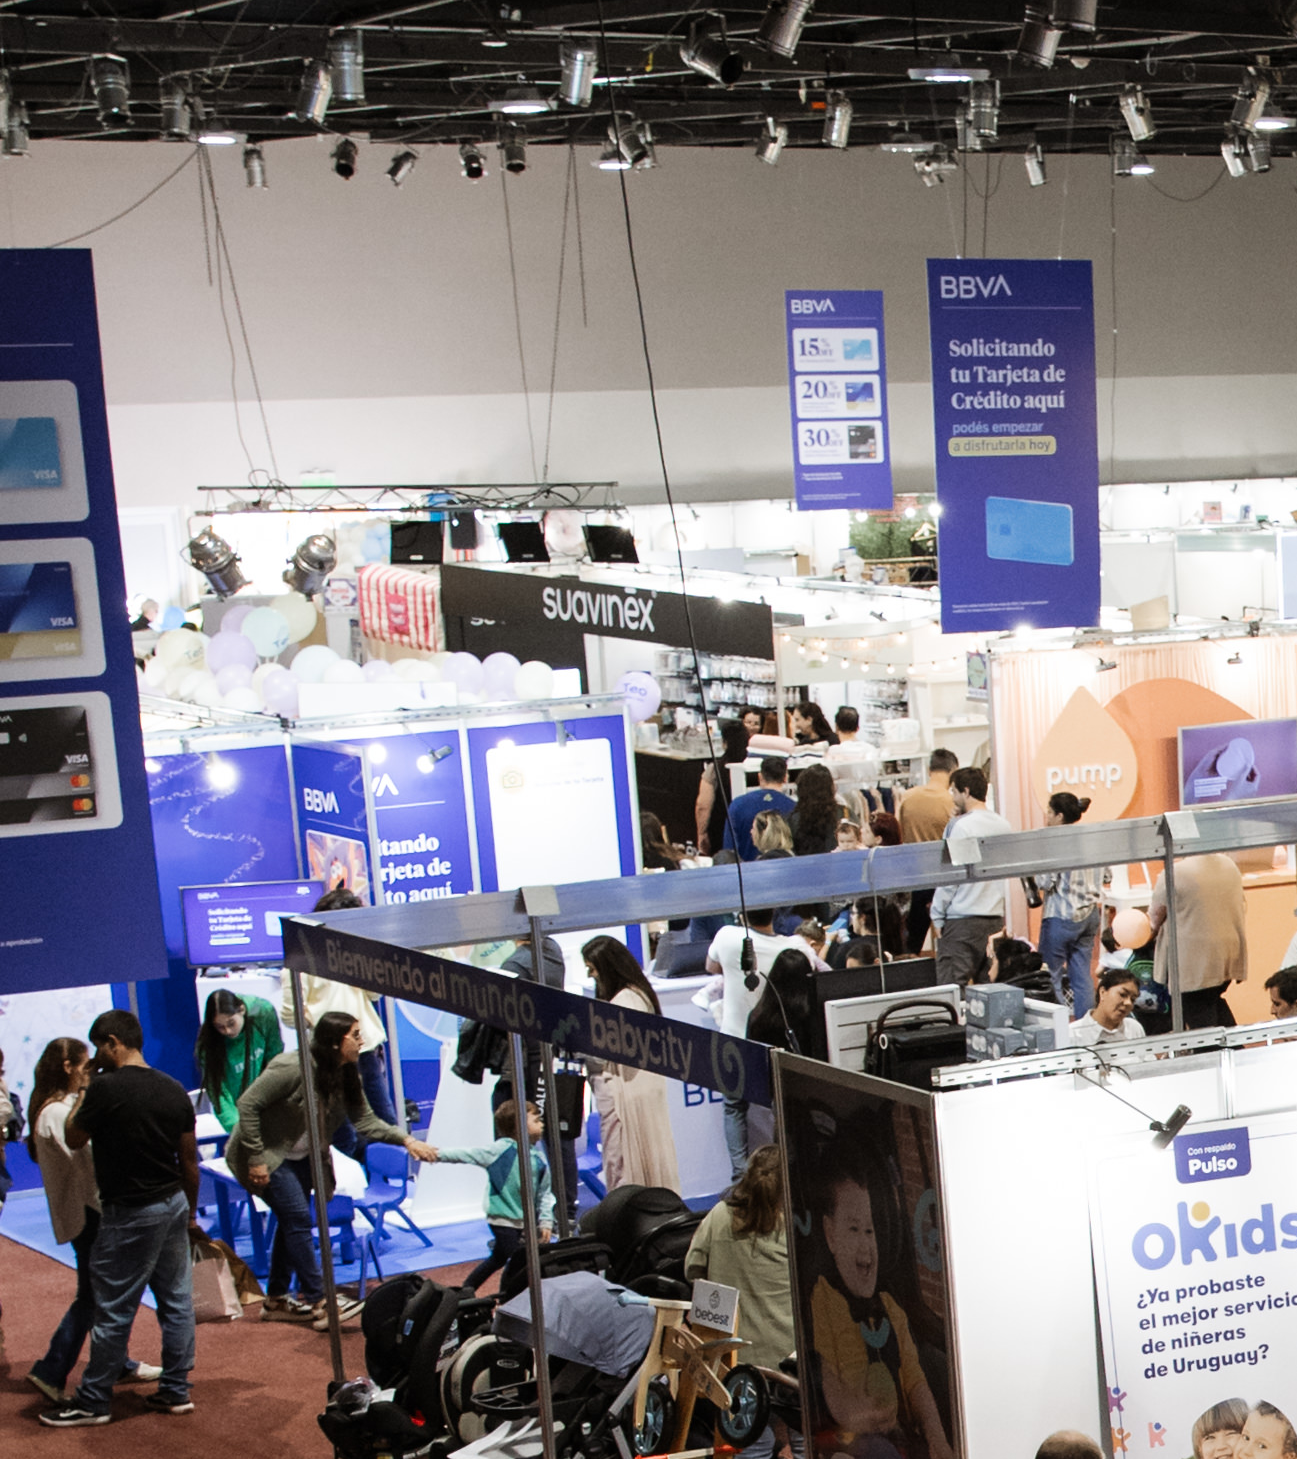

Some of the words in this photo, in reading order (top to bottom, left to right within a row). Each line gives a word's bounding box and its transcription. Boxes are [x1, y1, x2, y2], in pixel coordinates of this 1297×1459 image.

[941, 274, 1012, 298] BBVA
[791, 299, 835, 314] BBVA
[949, 339, 1055, 357] Solicitando
[950, 368, 970, 383] tu
[974, 365, 1039, 386] Tarjeta
[1043, 364, 1066, 382] de
[951, 391, 1021, 409] Crédito
[1024, 391, 1065, 413] aquí
[952, 421, 989, 435] podés
[992, 422, 1044, 434] empezar
[953, 443, 960, 451] a
[964, 439, 1025, 452] disfrutarla
[1029, 439, 1050, 452] hoy
[33, 469, 58, 480] VISA
[51, 617, 75, 627] VISA
[65, 754, 89, 764] VISA
[1046, 763, 1122, 790] pump
[304, 787, 340, 815] BBVA
[376, 833, 440, 856] itando
[428, 856, 452, 877] de
[326, 940, 425, 995] Bienvenido
[429, 974, 447, 1000] al
[450, 972, 542, 1029] mundo.
[587, 1001, 694, 1080] babycity
[1188, 1147, 1203, 1156] Con
[1204, 1141, 1236, 1155] respaldo
[1188, 1156, 1238, 1176] Pulso
[1137, 1288, 1170, 1310] ¿Ya
[1176, 1274, 1266, 1304] probaste
[695, 1309, 729, 1327] bebesit
[1139, 1313, 1157, 1331] el
[1162, 1305, 1218, 1327] mejor
[1141, 1338, 1167, 1355] de
[1171, 1326, 1247, 1351] niñeras
[1144, 1362, 1168, 1379] de
[1172, 1344, 1269, 1374] Uruguay?
